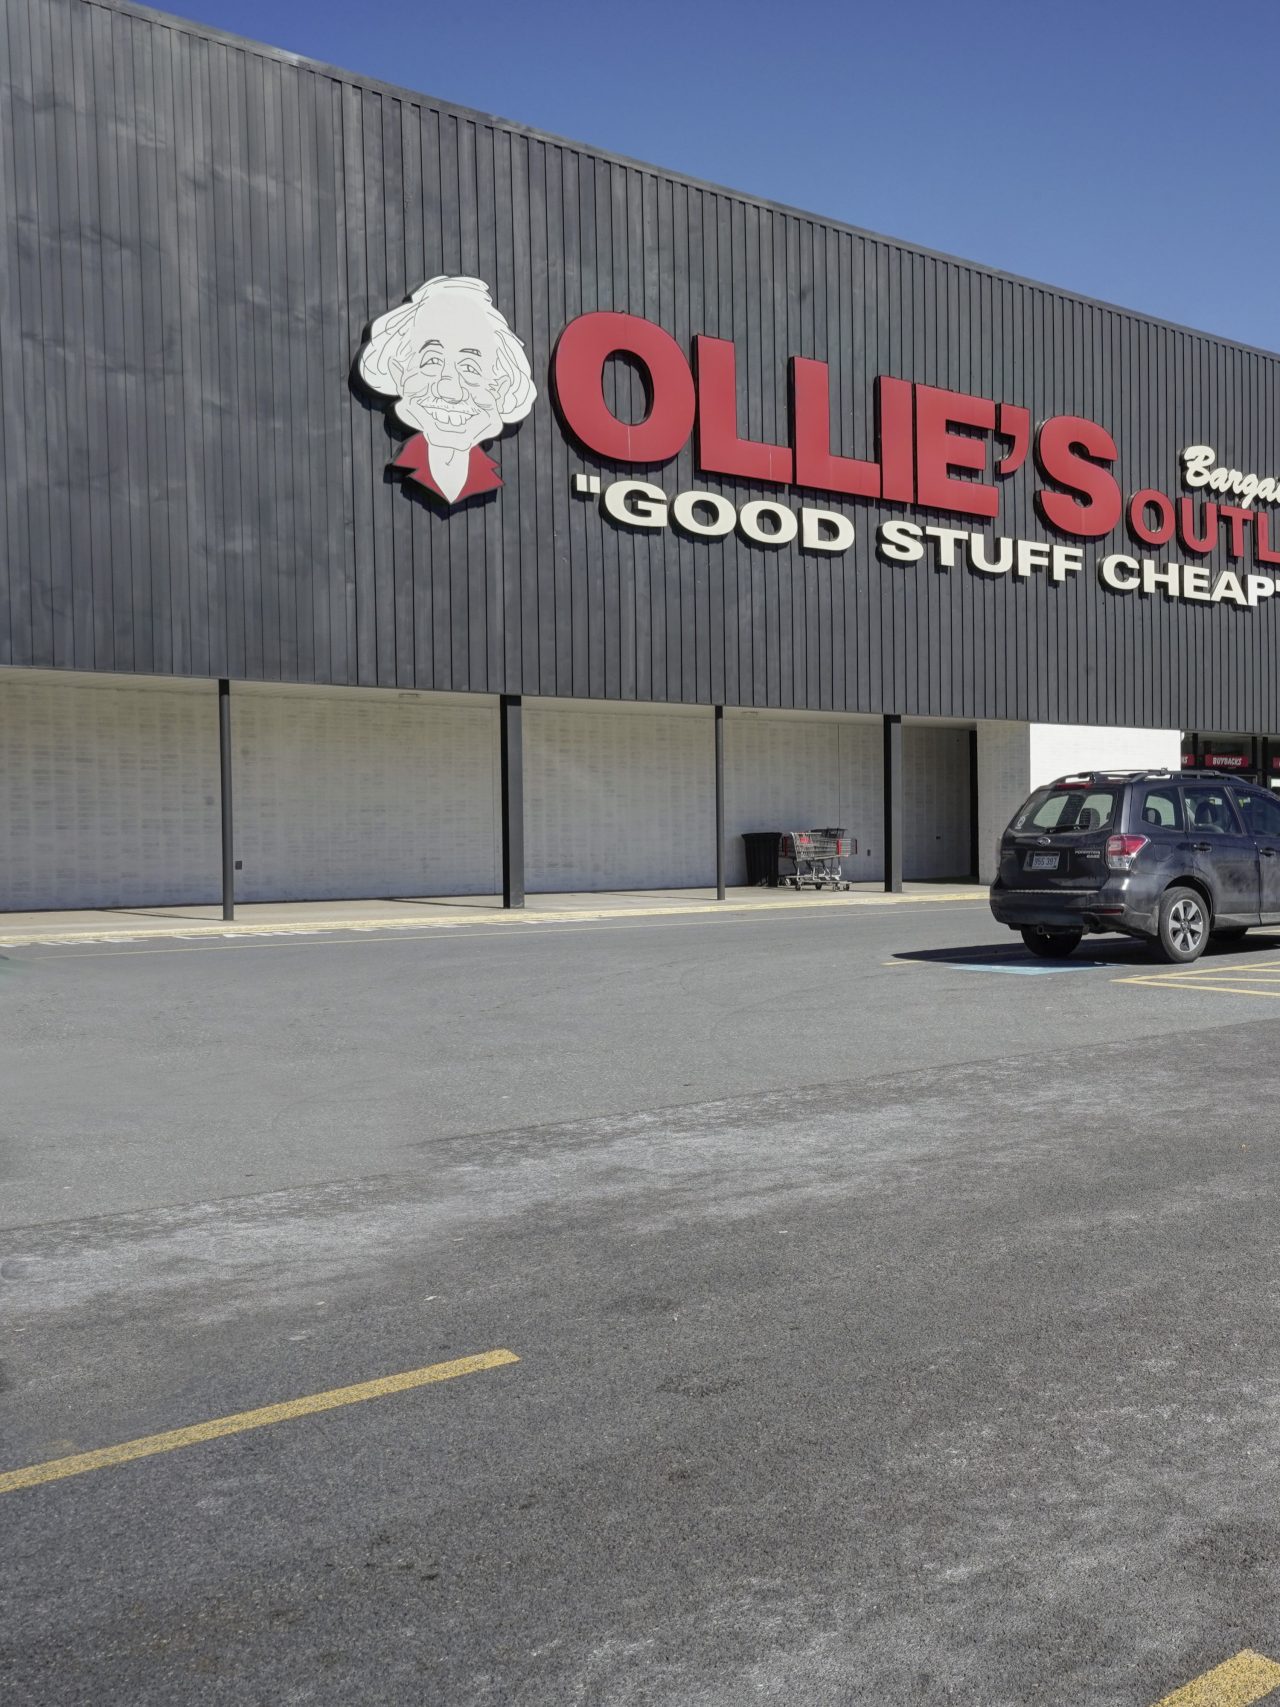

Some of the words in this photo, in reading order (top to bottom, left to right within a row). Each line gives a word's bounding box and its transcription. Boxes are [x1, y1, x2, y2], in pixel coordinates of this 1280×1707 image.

[552, 311, 1122, 537] OLLIE'S
[575, 473, 856, 552] "GOOD
[880, 519, 1084, 582] STUFF
[1213, 757, 1242, 766] BUYBACKS
